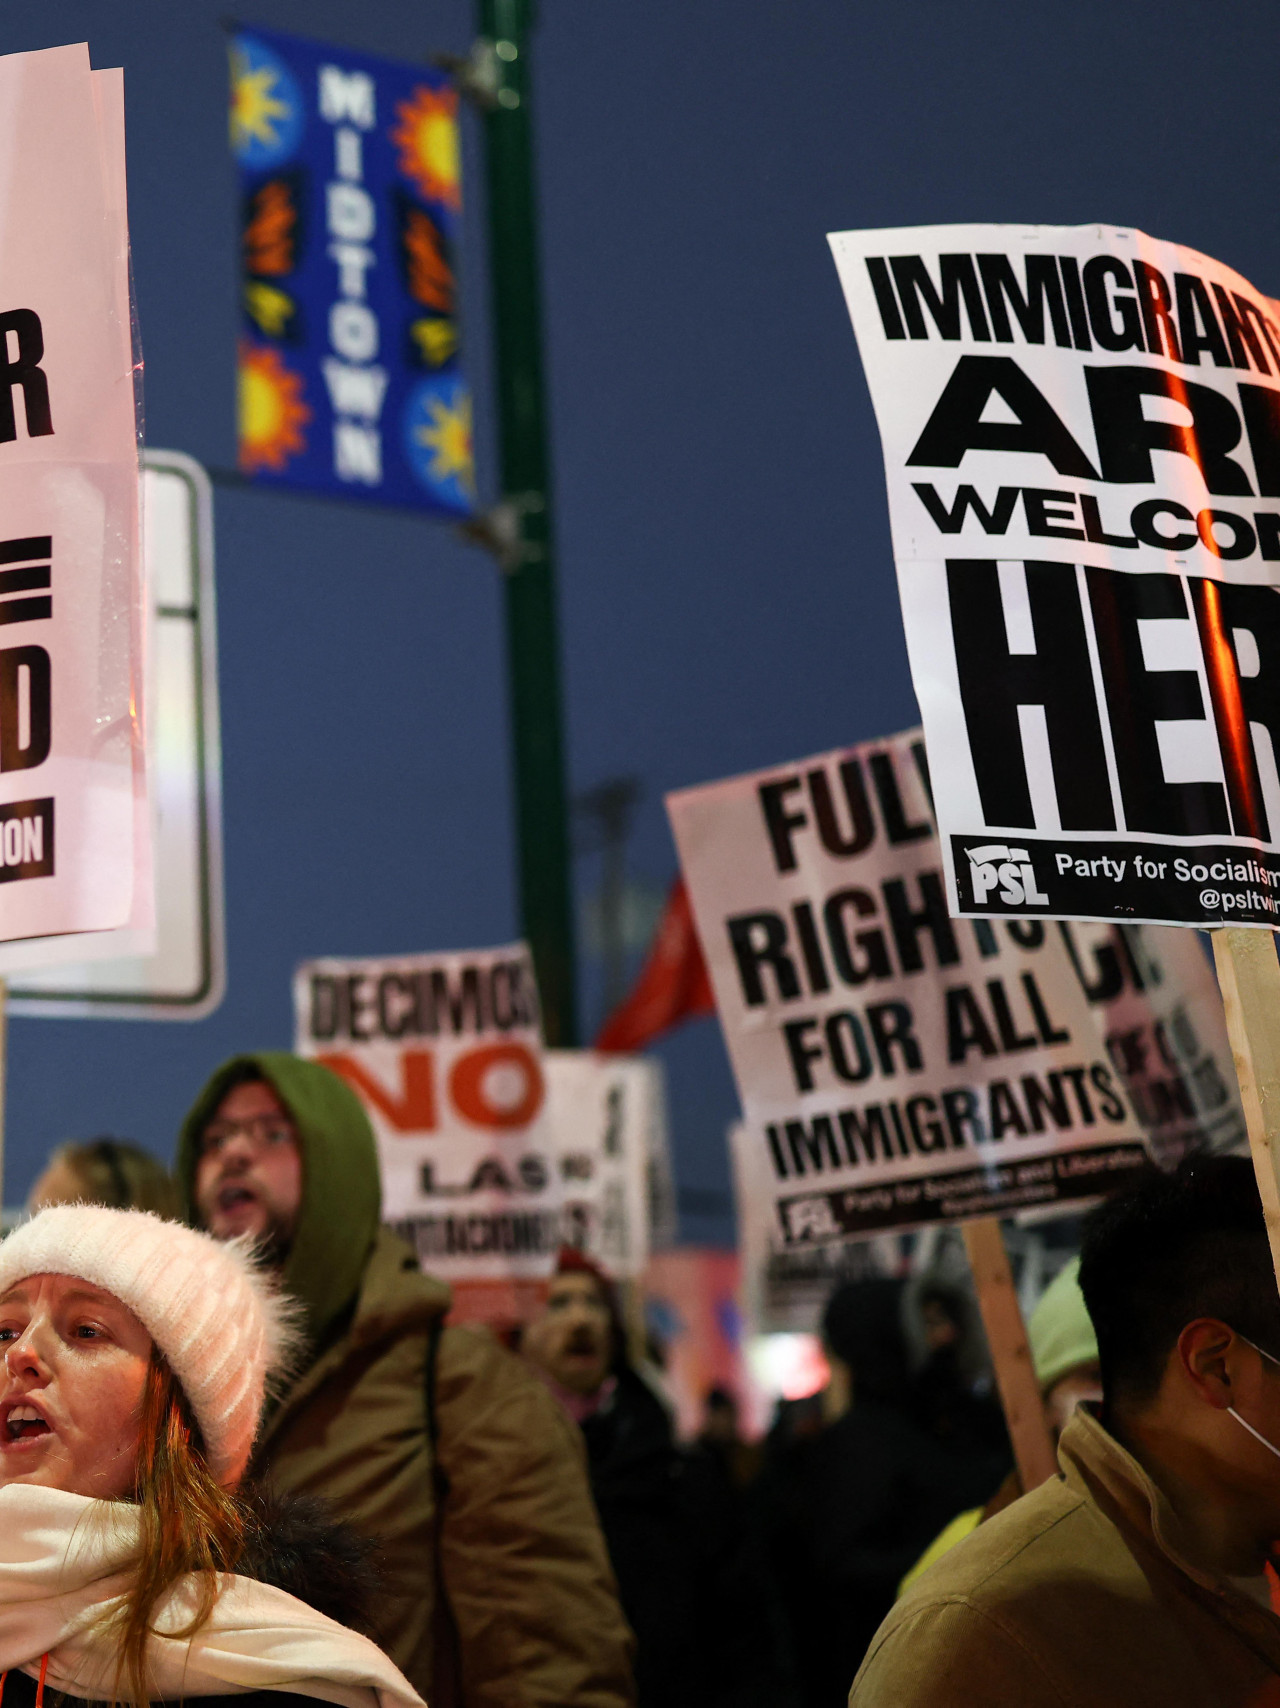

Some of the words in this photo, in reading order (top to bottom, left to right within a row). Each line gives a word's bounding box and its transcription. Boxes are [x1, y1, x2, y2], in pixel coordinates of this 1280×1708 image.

[319, 63, 388, 486] MIDTOWN
[758, 744, 935, 875] FUL
[1055, 853, 1127, 882] Party
[1133, 855, 1168, 880] for
[968, 855, 1050, 906] PSL
[313, 1042, 546, 1137] NO
[782, 997, 923, 1096] FOR
[945, 970, 1071, 1066] ALL
[766, 1061, 1127, 1182] IMMIGRANTS
